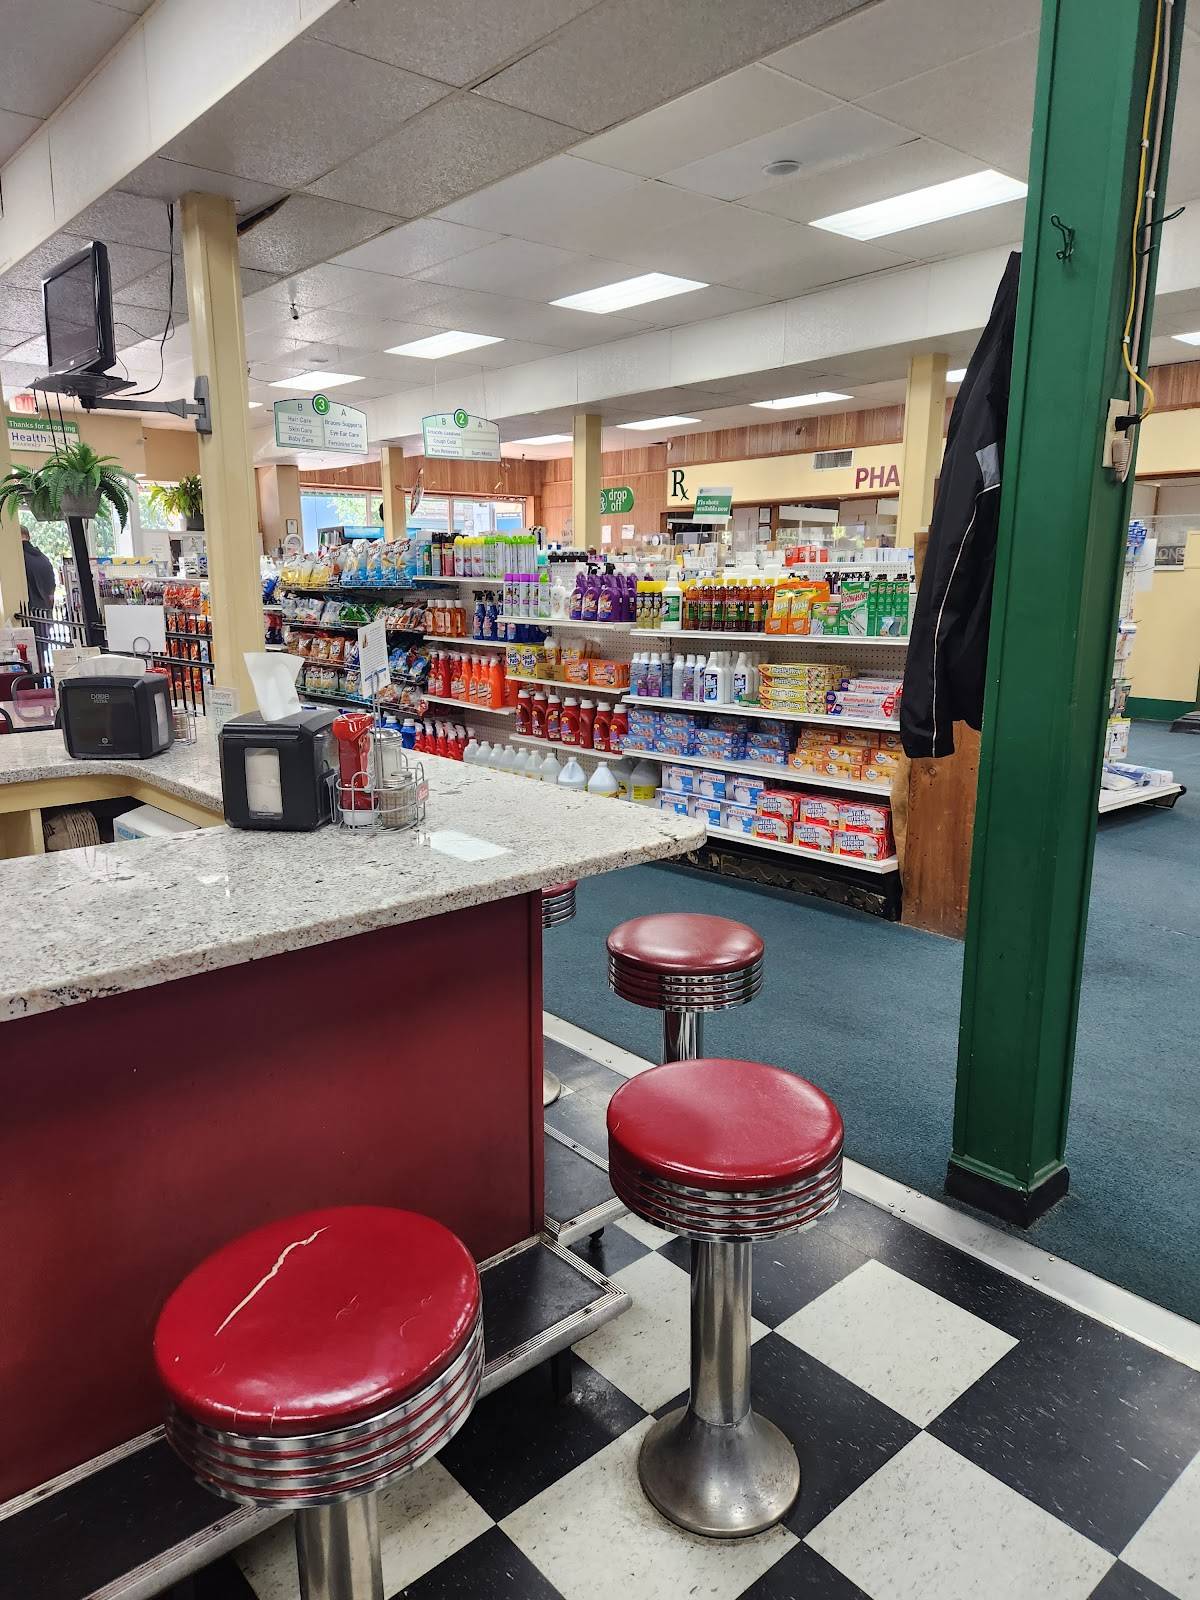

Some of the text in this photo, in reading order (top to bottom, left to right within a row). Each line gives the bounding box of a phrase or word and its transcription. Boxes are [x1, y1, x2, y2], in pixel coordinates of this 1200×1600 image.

[297, 403, 303, 411] B
[318, 399, 325, 410] 3
[341, 408, 346, 417] A
[300, 416, 312, 424] Care
[441, 417, 447, 425] B
[459, 413, 465, 424] 2
[8, 420, 34, 429] Thanks
[46, 425, 76, 433] soping
[301, 427, 313, 435] Care
[302, 436, 314, 444] Care
[855, 464, 900, 489] PHA
[608, 489, 628, 503] drop
[611, 501, 623, 512] off
